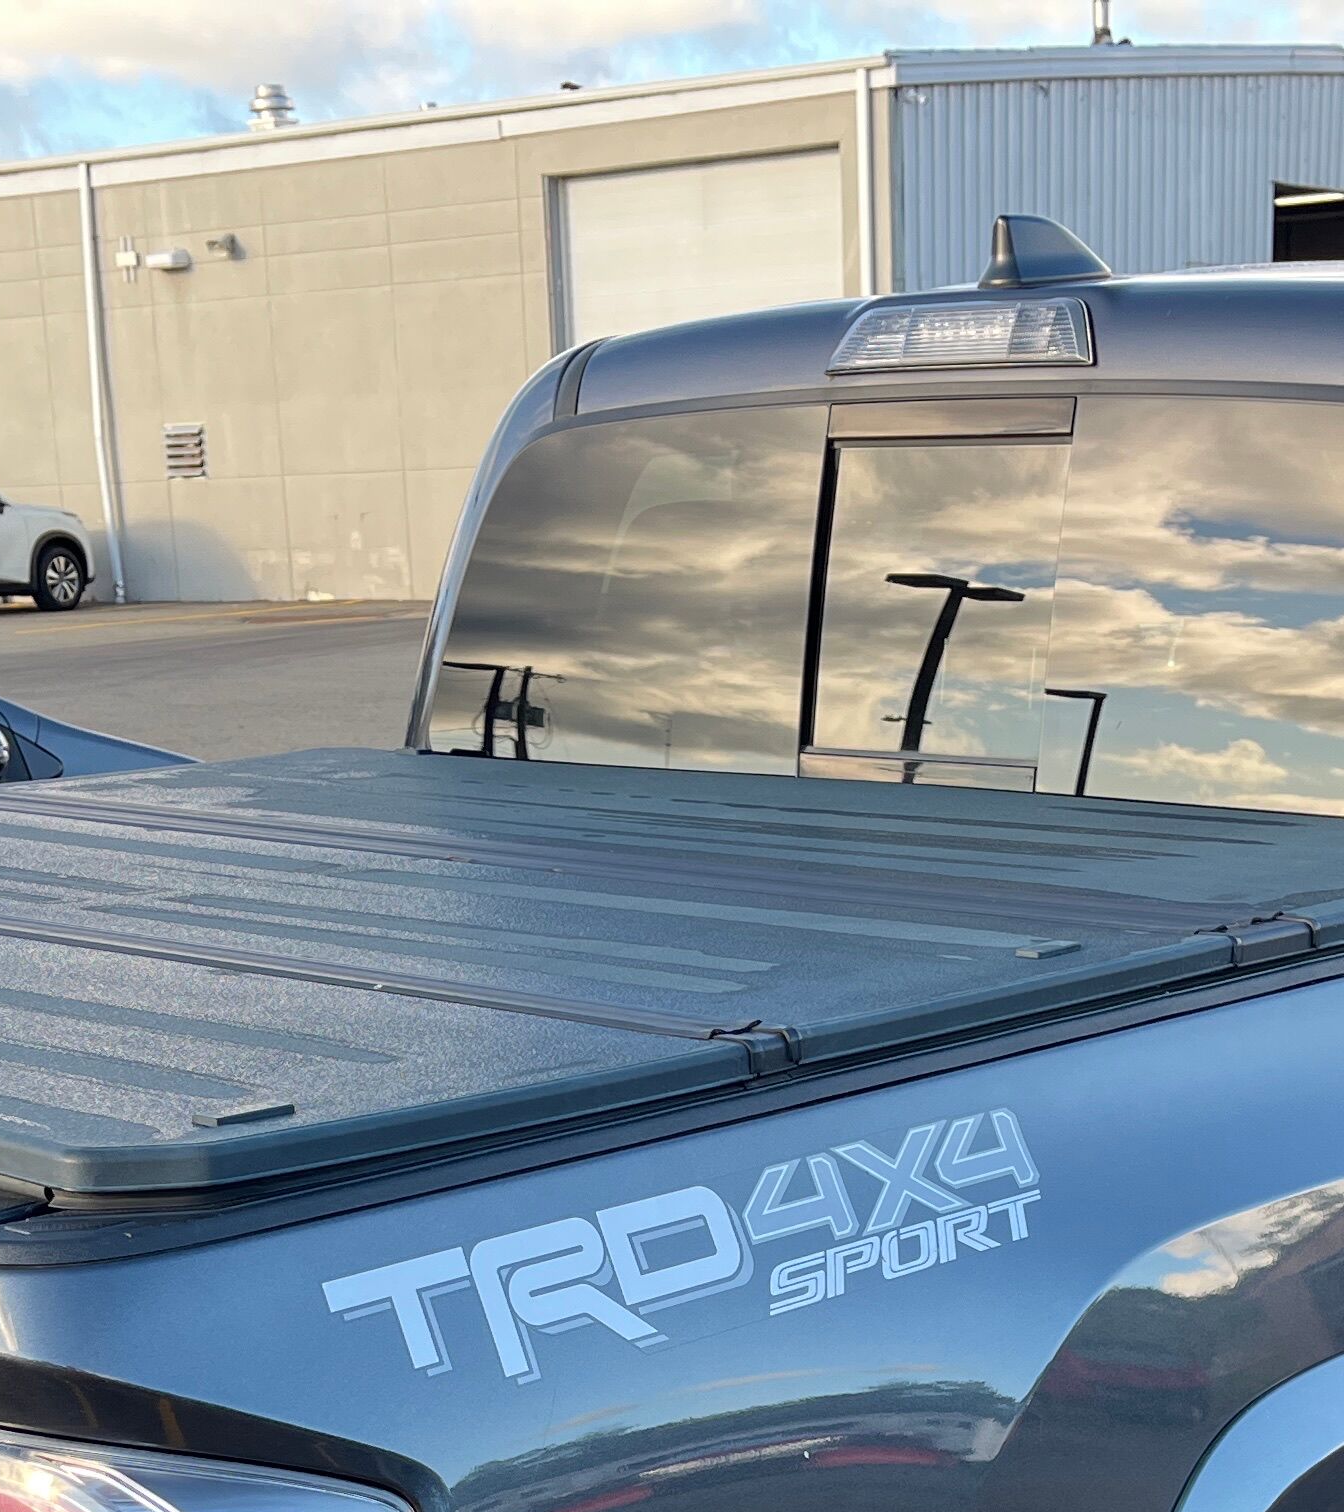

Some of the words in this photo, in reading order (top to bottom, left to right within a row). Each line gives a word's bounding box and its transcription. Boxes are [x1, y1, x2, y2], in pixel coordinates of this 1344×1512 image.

[322, 1185, 755, 1384] TRD
[742, 1107, 1042, 1241] 4X4
[770, 1190, 1042, 1315] SPORT
